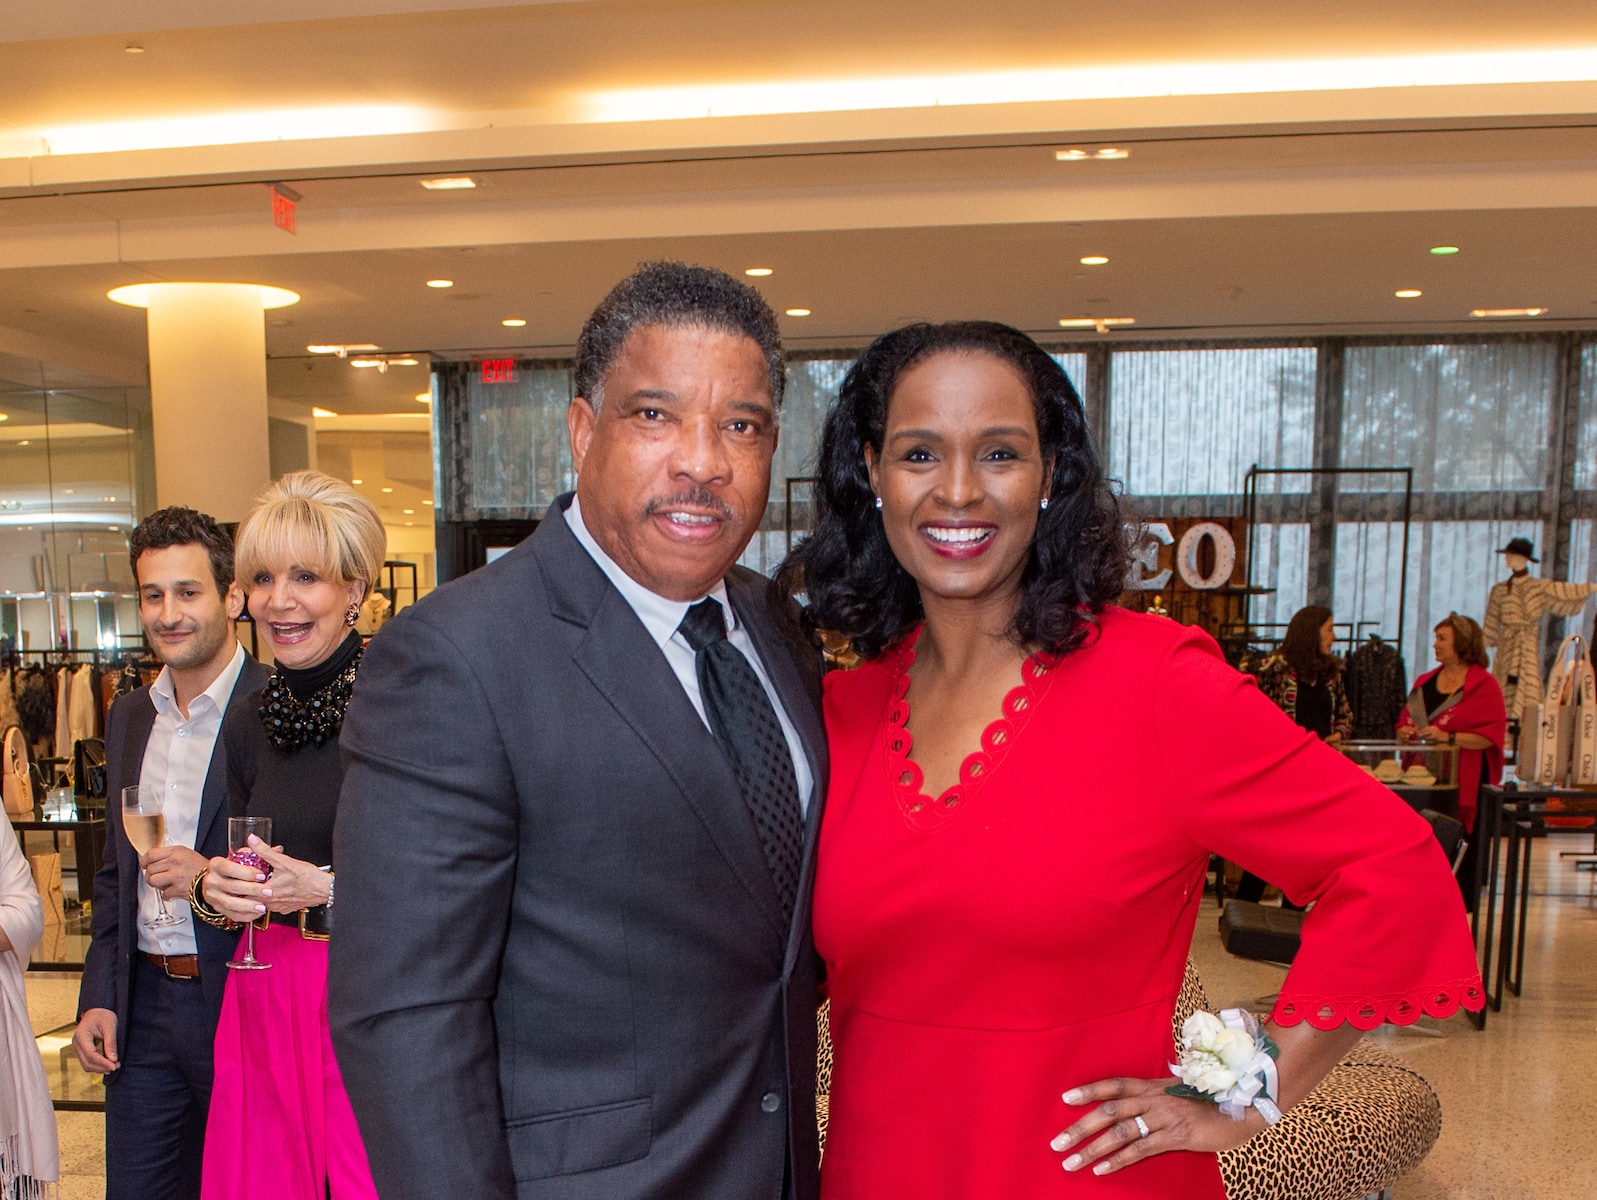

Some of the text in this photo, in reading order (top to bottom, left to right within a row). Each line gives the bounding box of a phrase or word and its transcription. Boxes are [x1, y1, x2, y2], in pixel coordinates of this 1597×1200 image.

[278, 195, 296, 233] EXIT
[482, 359, 514, 382] EXIT
[1550, 675, 1562, 700] Chloé
